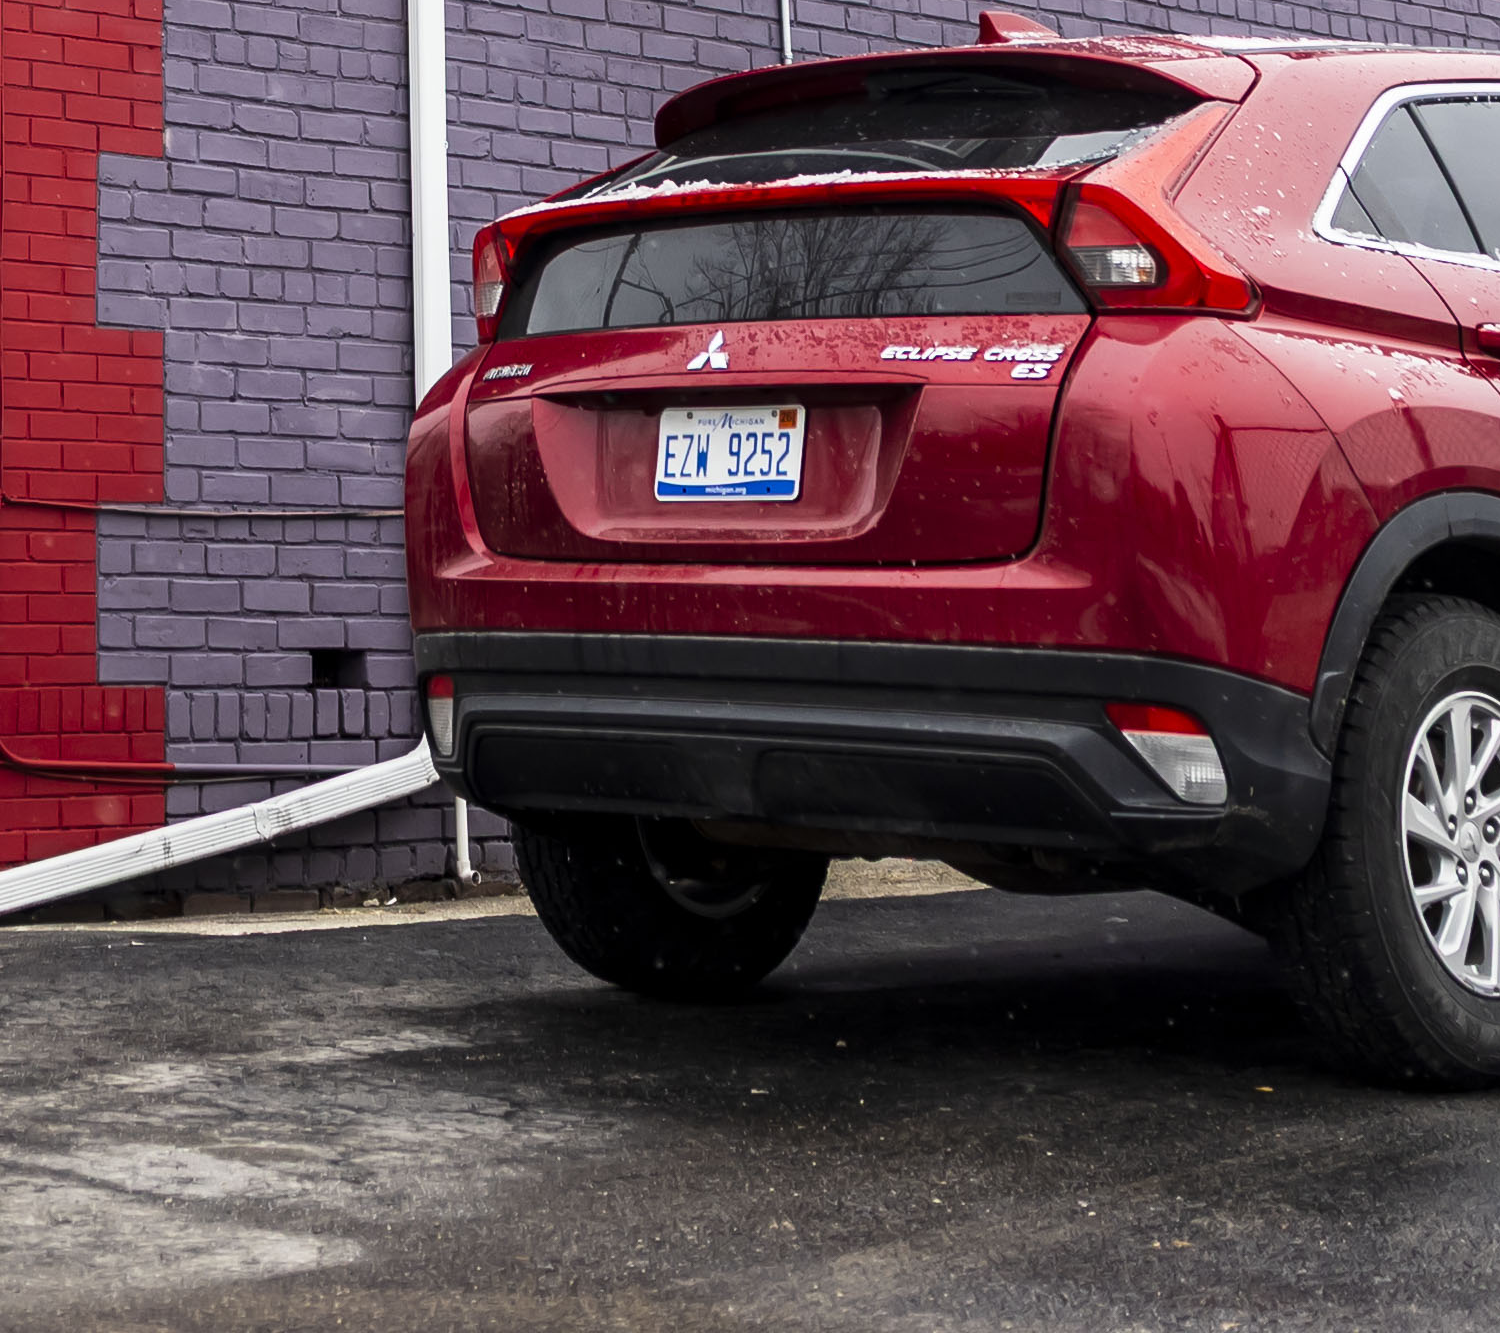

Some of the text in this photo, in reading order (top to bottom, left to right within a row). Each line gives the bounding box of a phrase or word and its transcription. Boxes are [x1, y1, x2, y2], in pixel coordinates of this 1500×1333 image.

[880, 345, 1066, 362] ECLIPSE CROSS
[1010, 363, 1054, 380] ES
[663, 431, 791, 479] EZW 9252
[705, 486, 747, 496] michigan.org
